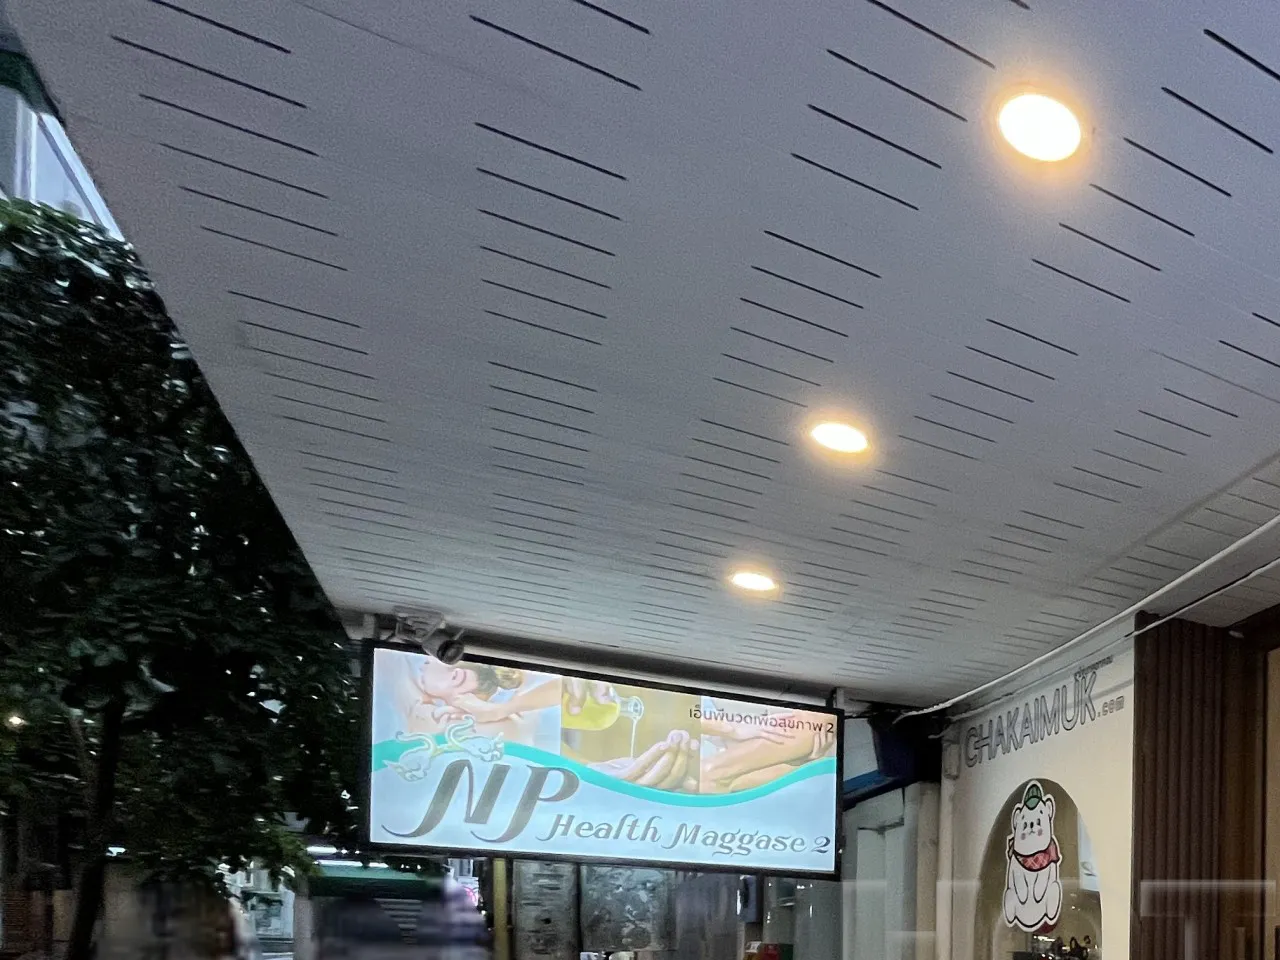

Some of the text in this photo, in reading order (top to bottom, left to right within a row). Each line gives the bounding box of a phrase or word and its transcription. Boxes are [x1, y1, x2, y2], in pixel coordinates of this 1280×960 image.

[826, 722, 835, 734] 2
[381, 758, 580, 844] NP
[535, 812, 831, 857] Health Maggase 2
